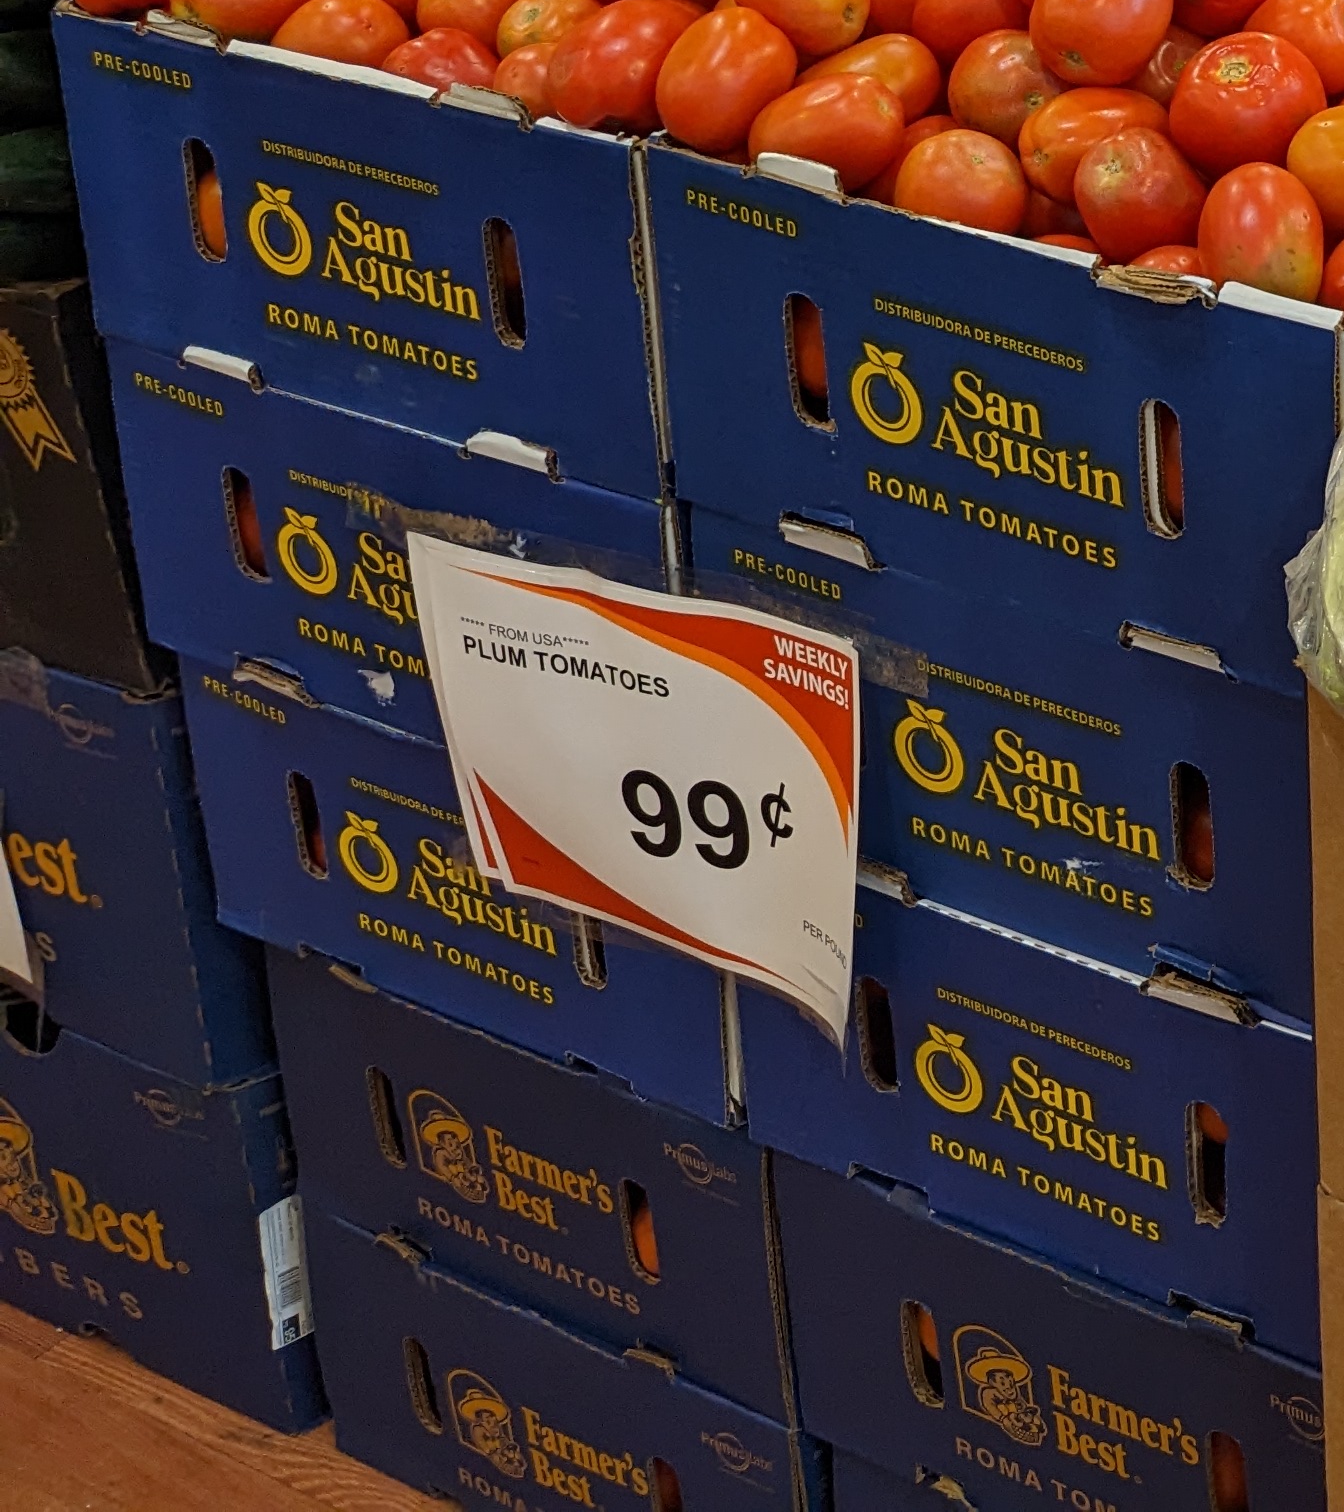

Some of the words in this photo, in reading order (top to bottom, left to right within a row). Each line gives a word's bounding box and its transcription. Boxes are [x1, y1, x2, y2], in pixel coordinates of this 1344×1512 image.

[94, 50, 191, 89] PRE-COOLED
[262, 140, 344, 174] DISTRIBUIDORA
[348, 160, 361, 176] DE
[364, 166, 439, 196] PERECEDEROS
[336, 201, 412, 260] San
[686, 190, 798, 237] PRE-COOLED
[322, 238, 481, 320] Agustin
[268, 304, 338, 340] ROMA
[348, 326, 478, 381] TOMATOES
[874, 298, 971, 340] DISTRIBUIDORA
[974, 325, 991, 345] DE
[993, 330, 1084, 372] PERECEDEROS
[135, 372, 223, 416] PRE-COOLED
[954, 369, 1042, 440] San
[931, 407, 1124, 507] Agustin
[868, 472, 948, 516] ROMA
[961, 499, 1118, 569] TOMATOES
[734, 549, 841, 600] PRE-COOLED
[299, 618, 366, 656] ROMA
[463, 635, 527, 668] PLUM
[534, 651, 669, 697] TOMATOES
[488, 623, 529, 642] FROM
[774, 635, 848, 678] WEEKLY
[204, 676, 286, 724] PRE-COOLED
[764, 659, 849, 710] SAVINGS!
[917, 659, 1012, 700] DISTRIBUIDORA
[1014, 689, 1031, 706] DE
[1033, 695, 1121, 736] PERECEDEROS
[993, 728, 1082, 796] San
[351, 778, 429, 814] DISTRIBUIDORA
[430, 806, 444, 821] DE
[974, 760, 1161, 861] Agustin
[420, 838, 491, 897] San
[911, 816, 991, 861] ROMA
[1001, 847, 1153, 916] TOMATOES
[407, 865, 557, 956] Agustin
[803, 920, 823, 944] PER
[824, 934, 847, 970] POUND
[359, 913, 425, 951] ROMA
[433, 941, 554, 1004] TOMATOES
[937, 988, 1028, 1030] DISTRIBUIDORA
[1029, 1021, 1046, 1037] DE
[1048, 1028, 1131, 1070] PERECEDEROS
[1010, 1054, 1095, 1123] San
[484, 1125, 614, 1215] Farmer's
[991, 1086, 1168, 1189] Agustin
[51, 1169, 173, 1271] Best
[492, 1170, 559, 1231] Best
[930, 1133, 1008, 1179] ROMA
[1017, 1166, 1161, 1242] TOMATOES
[418, 1197, 490, 1246] ROMA
[496, 1235, 641, 1316] TOMATOES
[1047, 1364, 1199, 1465] Farmer's
[1052, 1411, 1130, 1480] Best
[521, 1406, 649, 1497] Farmer's
[529, 1449, 597, 1508] Best
[955, 1437, 1042, 1492] ROMA
